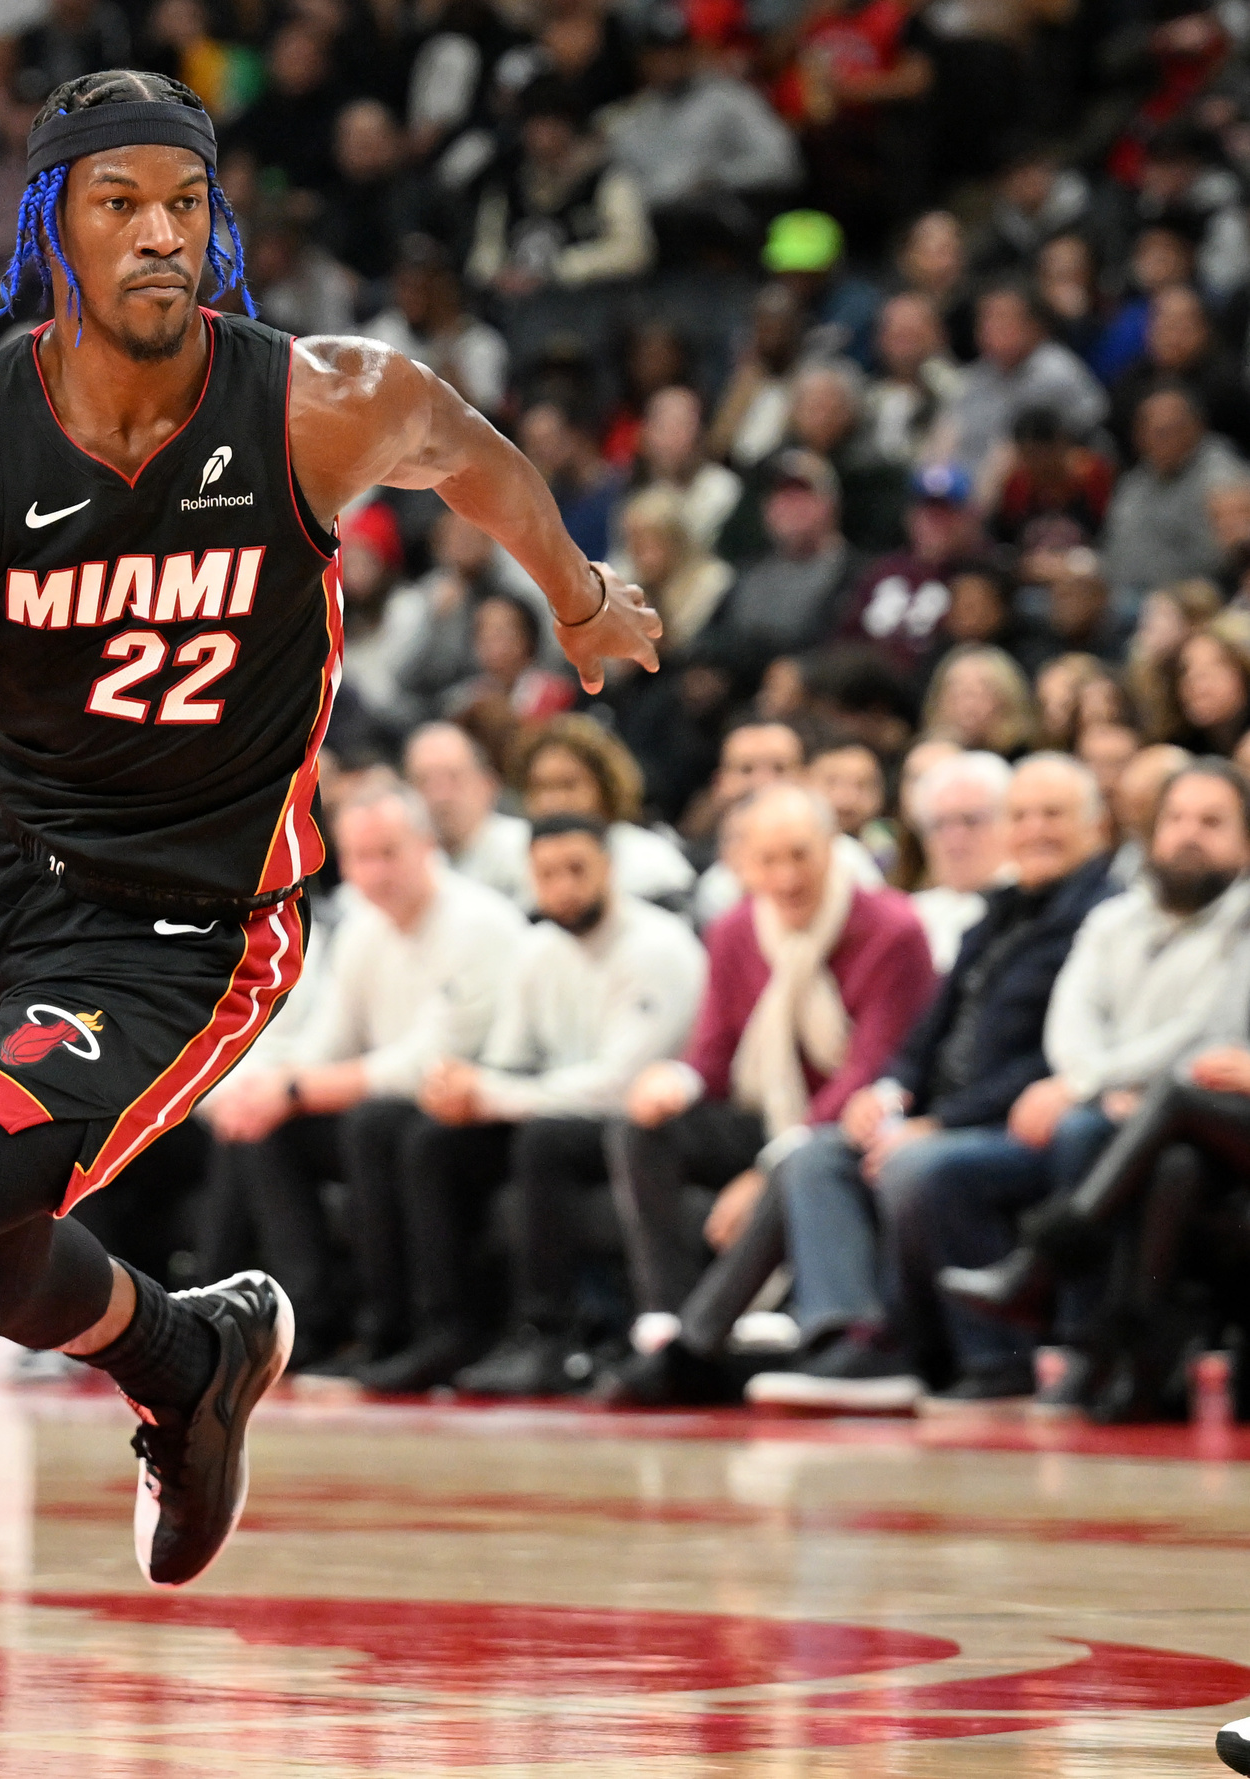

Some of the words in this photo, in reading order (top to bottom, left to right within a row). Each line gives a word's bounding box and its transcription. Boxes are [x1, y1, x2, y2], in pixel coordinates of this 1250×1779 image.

[180, 491, 254, 512] Robinhood
[5, 545, 267, 629] MIAMI
[84, 629, 241, 724] 22
